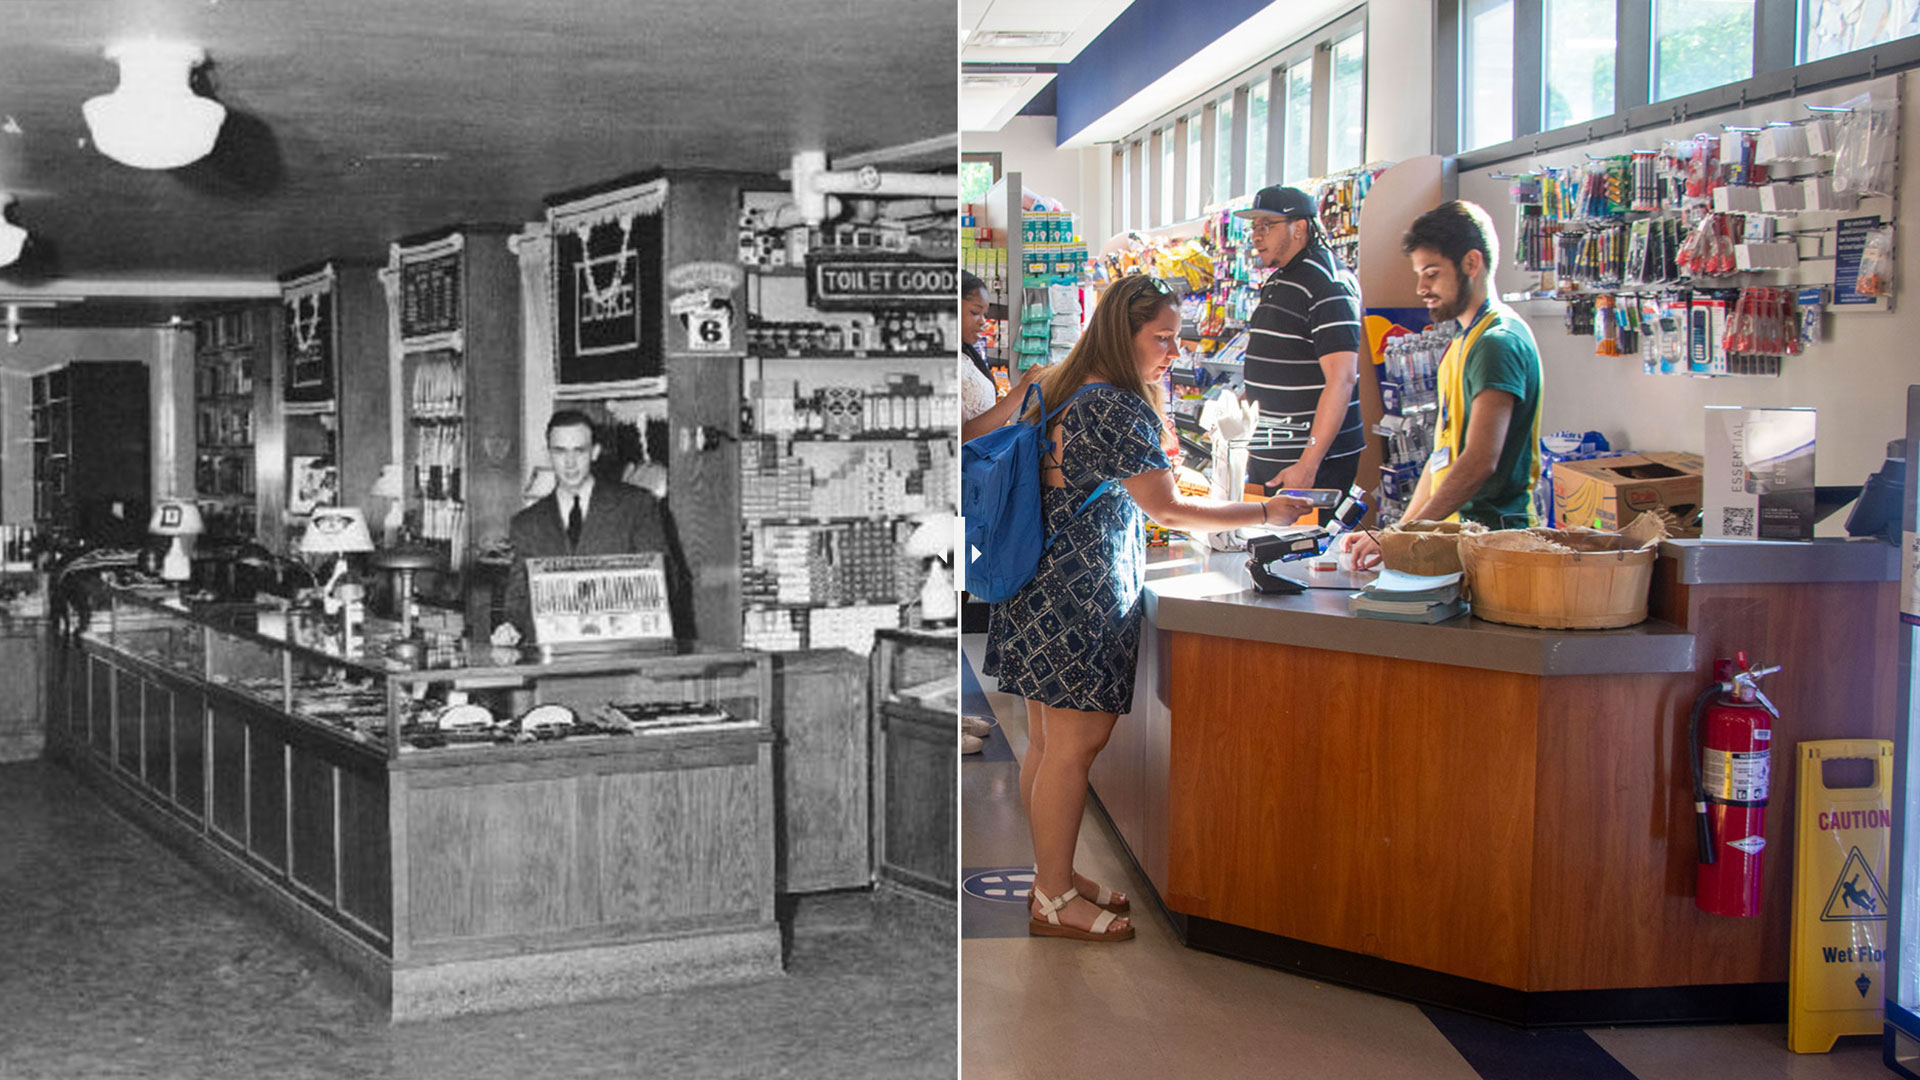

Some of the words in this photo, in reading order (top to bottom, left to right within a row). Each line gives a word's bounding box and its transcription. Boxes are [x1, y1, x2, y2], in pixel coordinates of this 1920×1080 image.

[824, 271, 893, 290] TOILET
[699, 320, 723, 343] 6
[1731, 422, 1743, 493] ESSENTIAL
[1818, 808, 1891, 831] CAUTION
[1822, 946, 1853, 963] Wet
